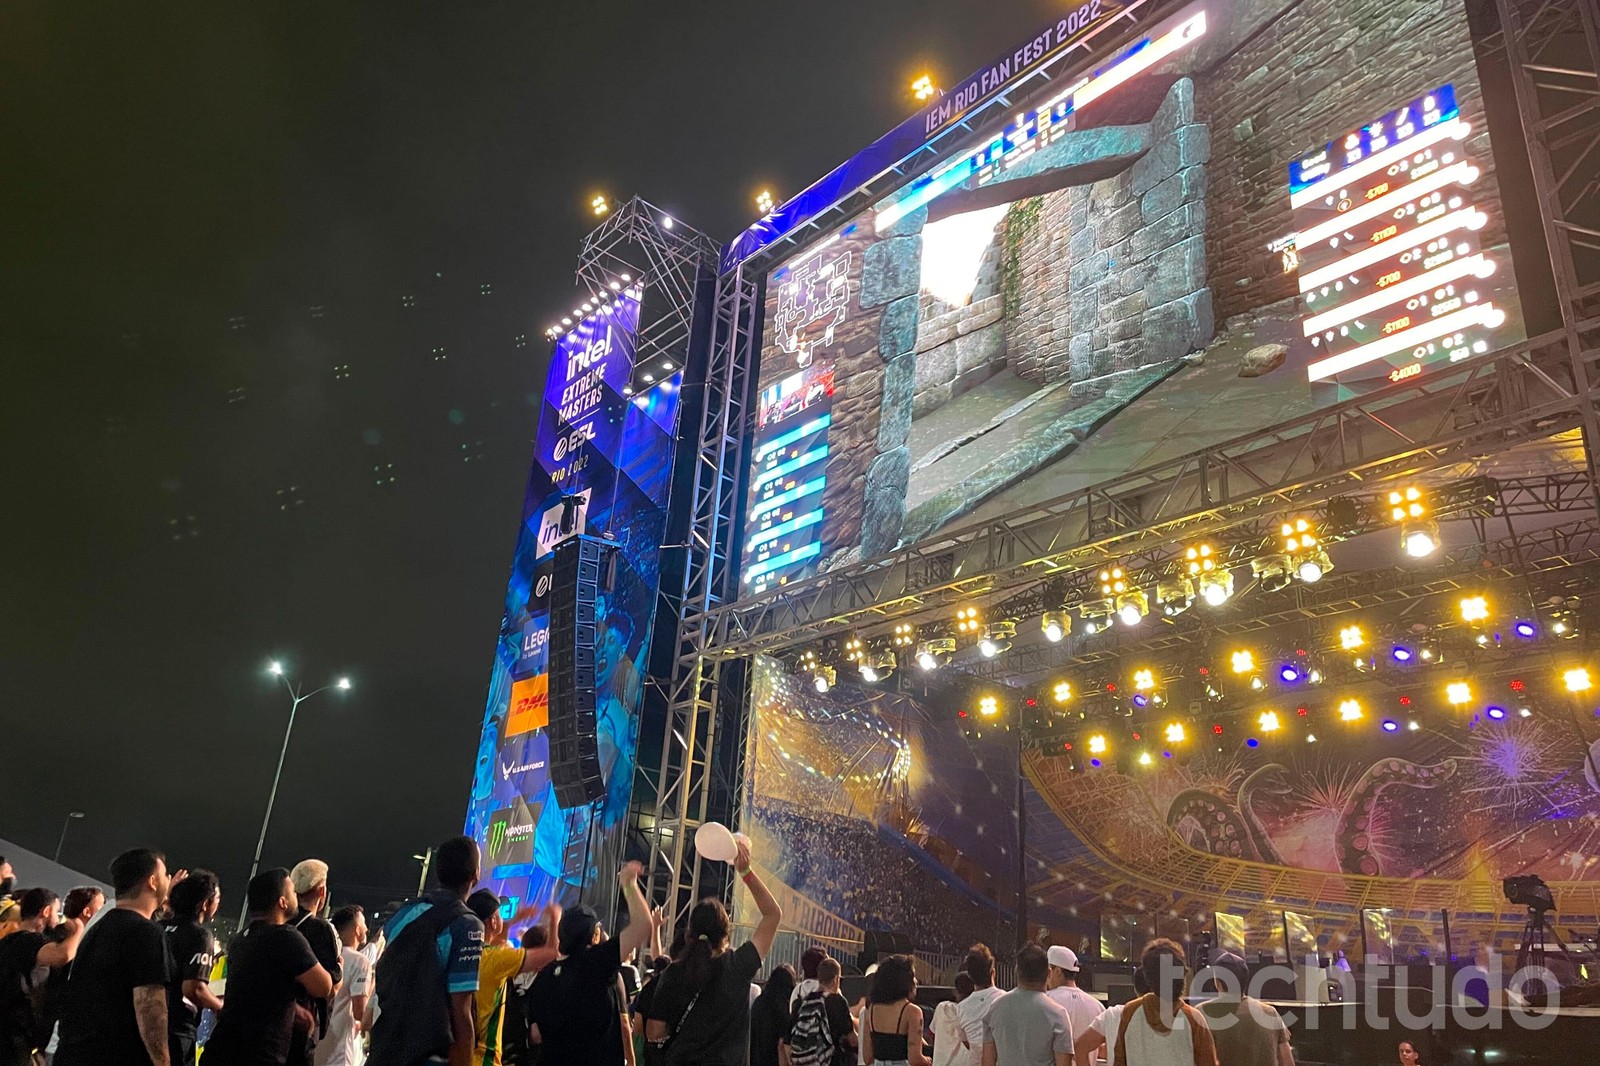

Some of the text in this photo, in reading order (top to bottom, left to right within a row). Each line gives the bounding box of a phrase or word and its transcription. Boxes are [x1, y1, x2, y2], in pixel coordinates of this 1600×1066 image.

[925, 0, 1101, 133] IEM RIO FAN FEST 2022
[557, 384, 603, 426] MASTERS
[561, 362, 607, 406] EXTREME
[568, 421, 596, 452] ESL
[567, 454, 589, 477] 2022
